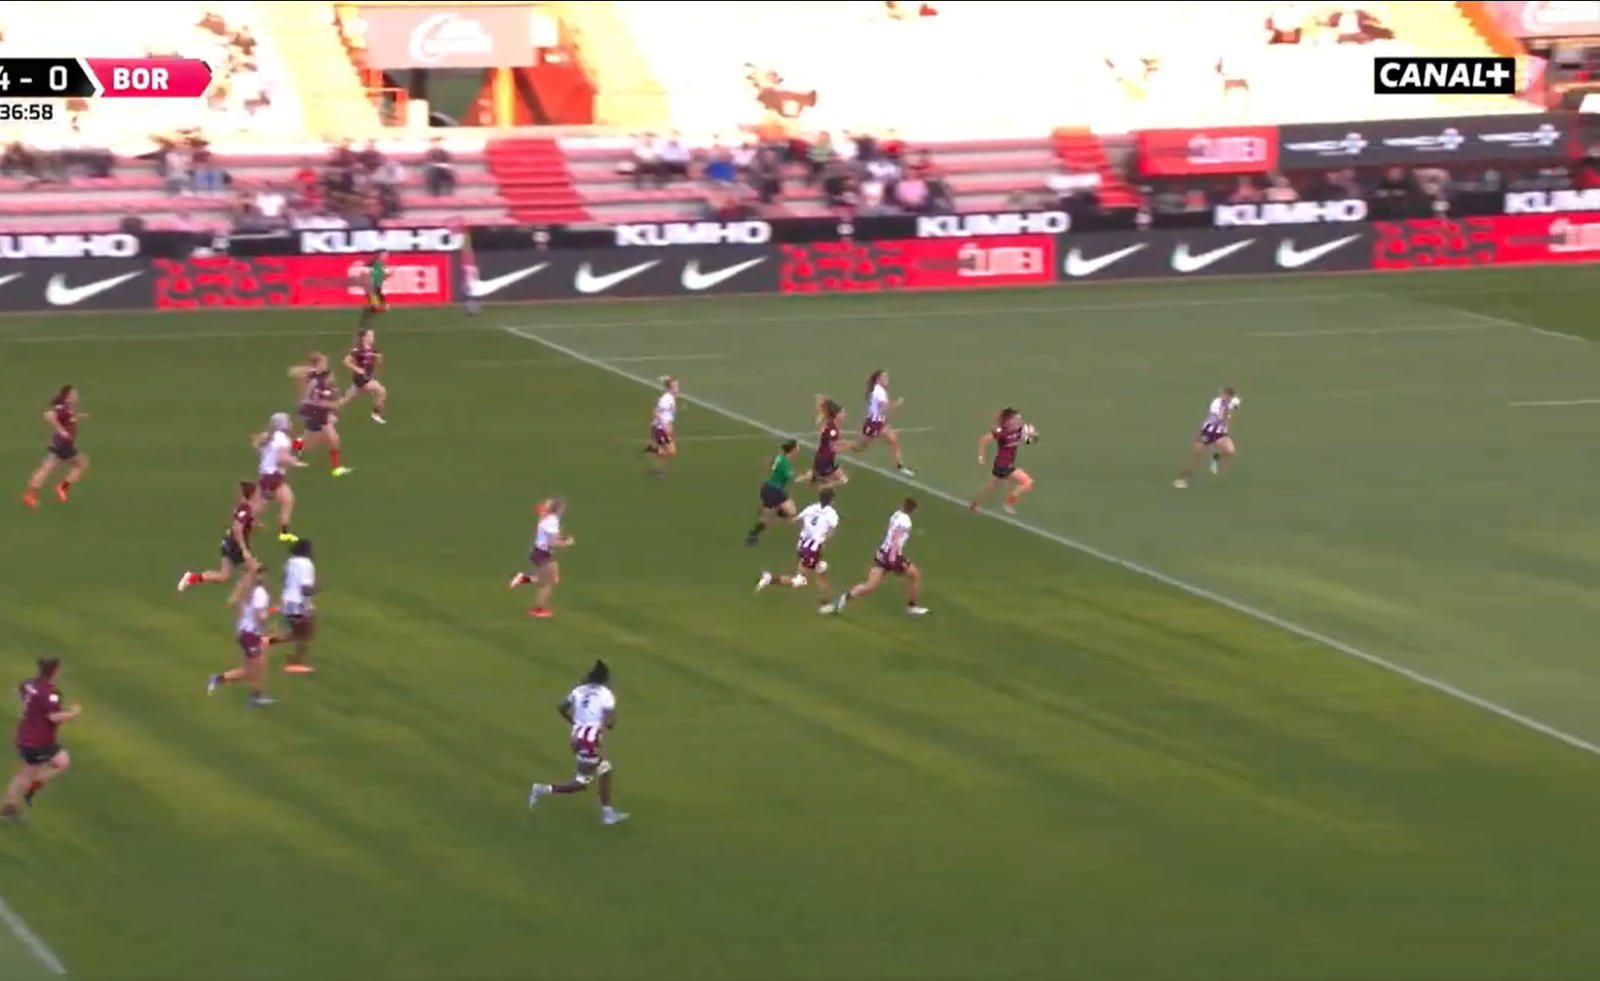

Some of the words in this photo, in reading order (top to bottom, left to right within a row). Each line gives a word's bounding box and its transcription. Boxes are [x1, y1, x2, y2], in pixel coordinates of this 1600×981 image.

[1214, 199, 1368, 226] KUMHO
[1504, 188, 1600, 213] KUM
[615, 221, 772, 246] KUMHO
[916, 211, 1070, 238] KUMHO
[0, 233, 140, 259] UMHO
[301, 229, 463, 253] KUMHO
